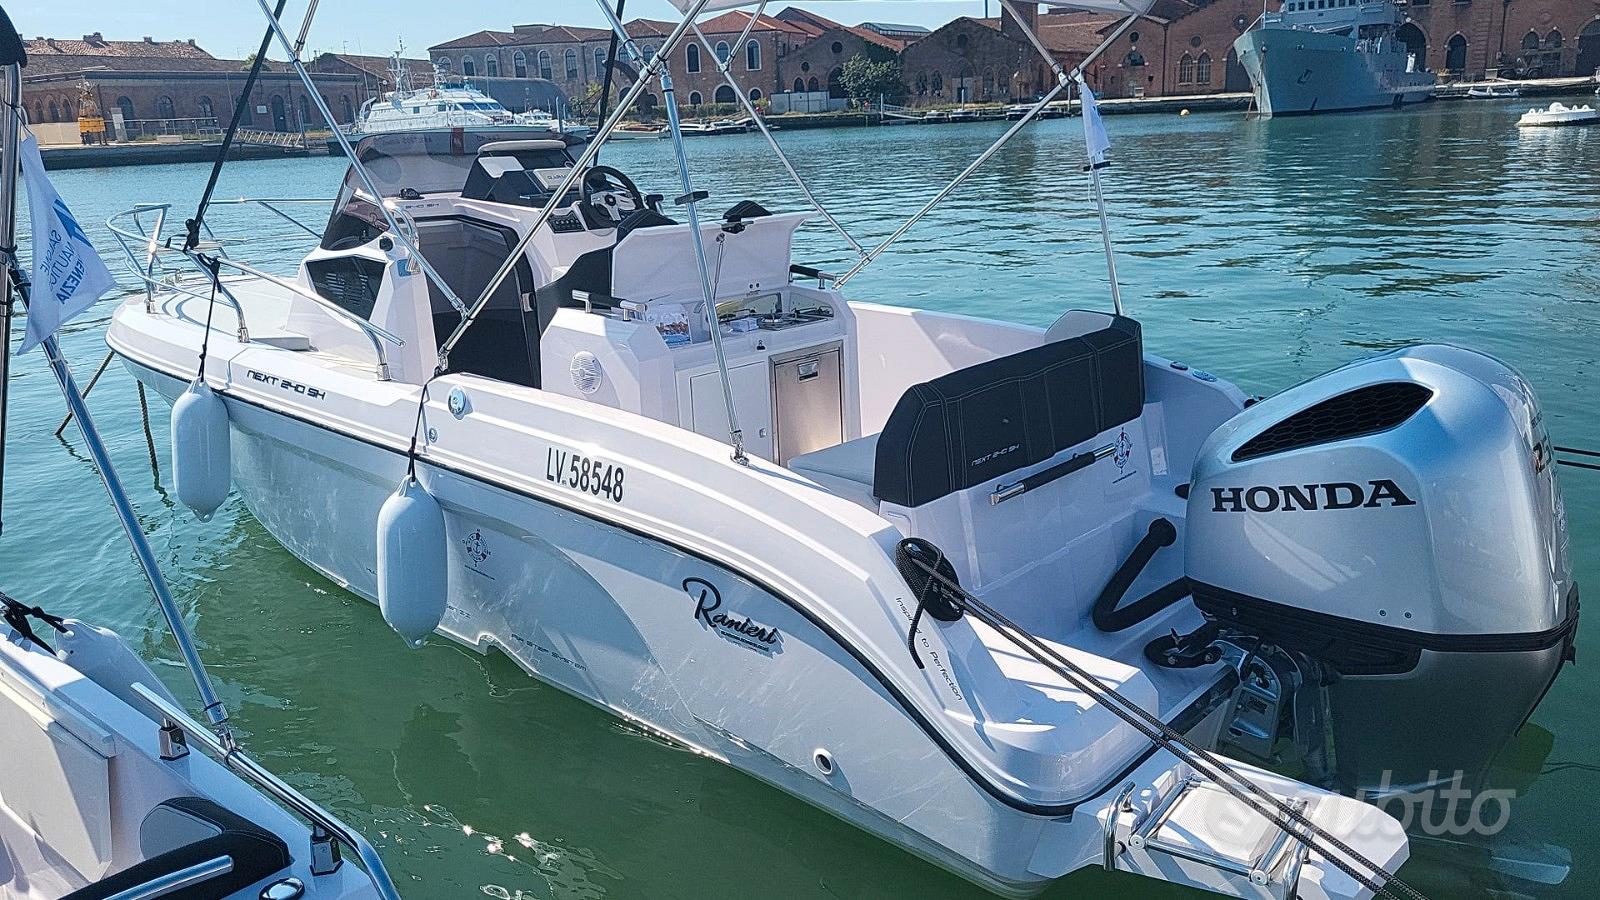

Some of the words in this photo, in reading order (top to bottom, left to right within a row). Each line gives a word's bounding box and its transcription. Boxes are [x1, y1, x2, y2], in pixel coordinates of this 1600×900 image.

[246, 369, 281, 387] NEXT
[281, 378, 305, 394] 240
[306, 387, 326, 401] SH
[546, 446, 625, 503] LV.58548
[1210, 479, 1416, 513] HONDA
[682, 576, 778, 645] Ranieri
[895, 597, 923, 638] Inspird
[921, 635, 930, 649] to
[929, 650, 963, 702] Perfection
